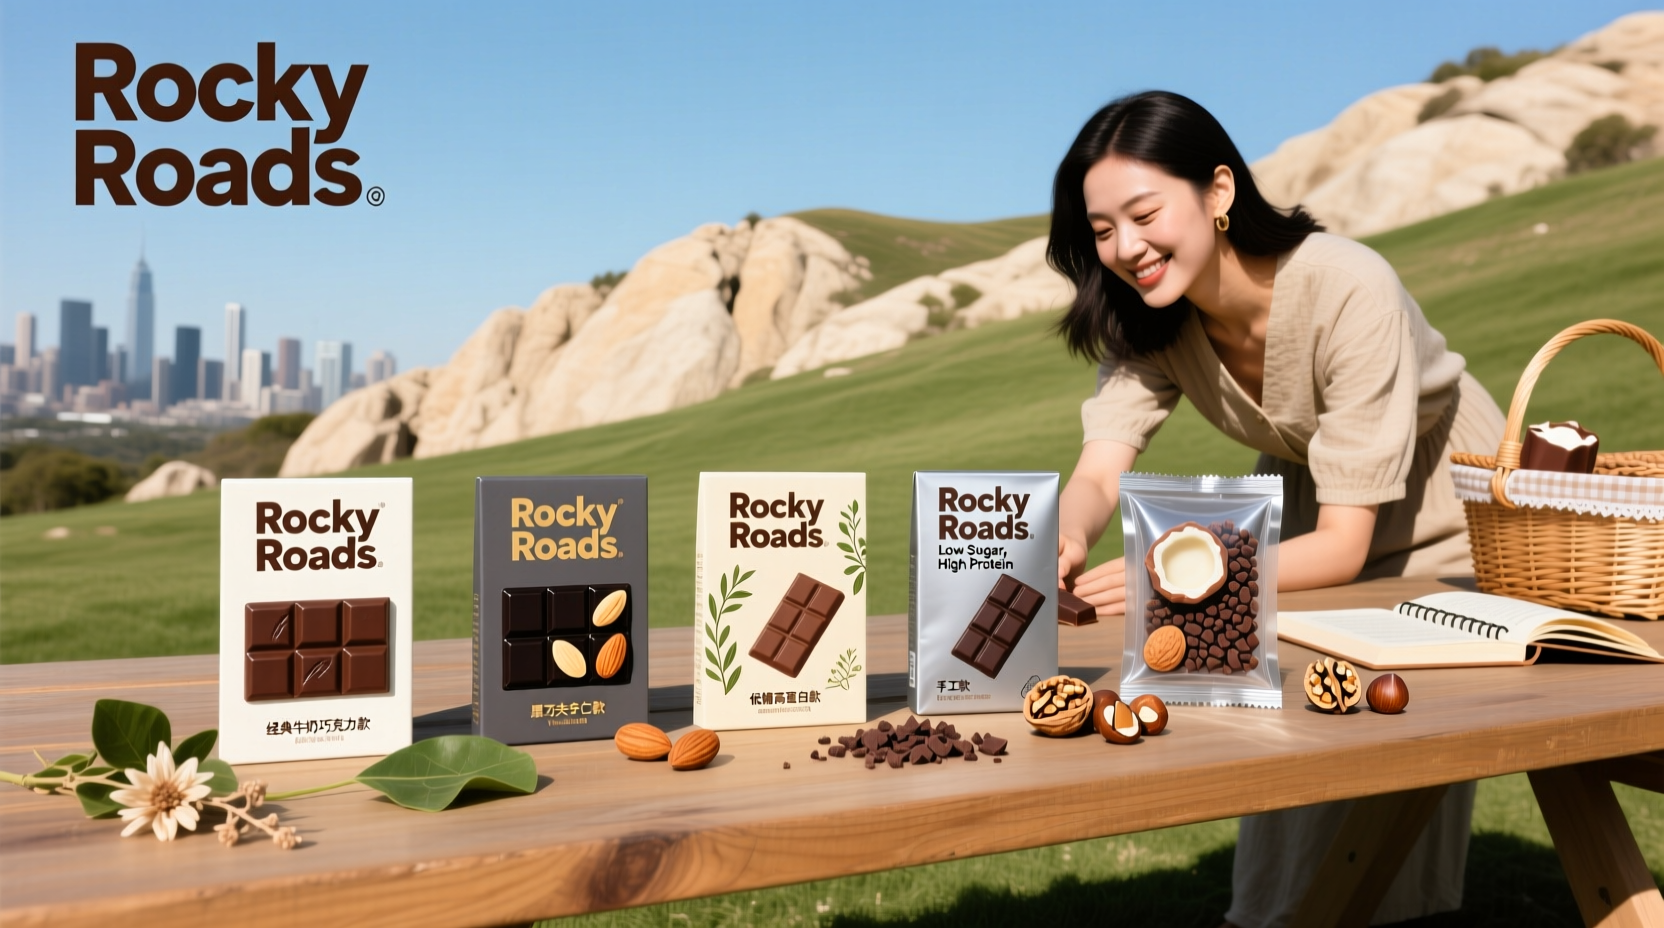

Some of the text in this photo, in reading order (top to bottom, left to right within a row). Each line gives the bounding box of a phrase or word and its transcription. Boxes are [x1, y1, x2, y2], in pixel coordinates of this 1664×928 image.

[512, 496, 618, 535] Rocky
[730, 492, 824, 526] Rocky
[939, 486, 1030, 519] Rocky
[256, 499, 379, 542] Rocky
[730, 522, 823, 548] Roads
[939, 514, 1029, 540] Roads
[256, 537, 377, 571] Roads
[512, 528, 617, 561] Roads
[939, 544, 1007, 559] Low Sugar,
[938, 557, 1013, 573] High Protein
